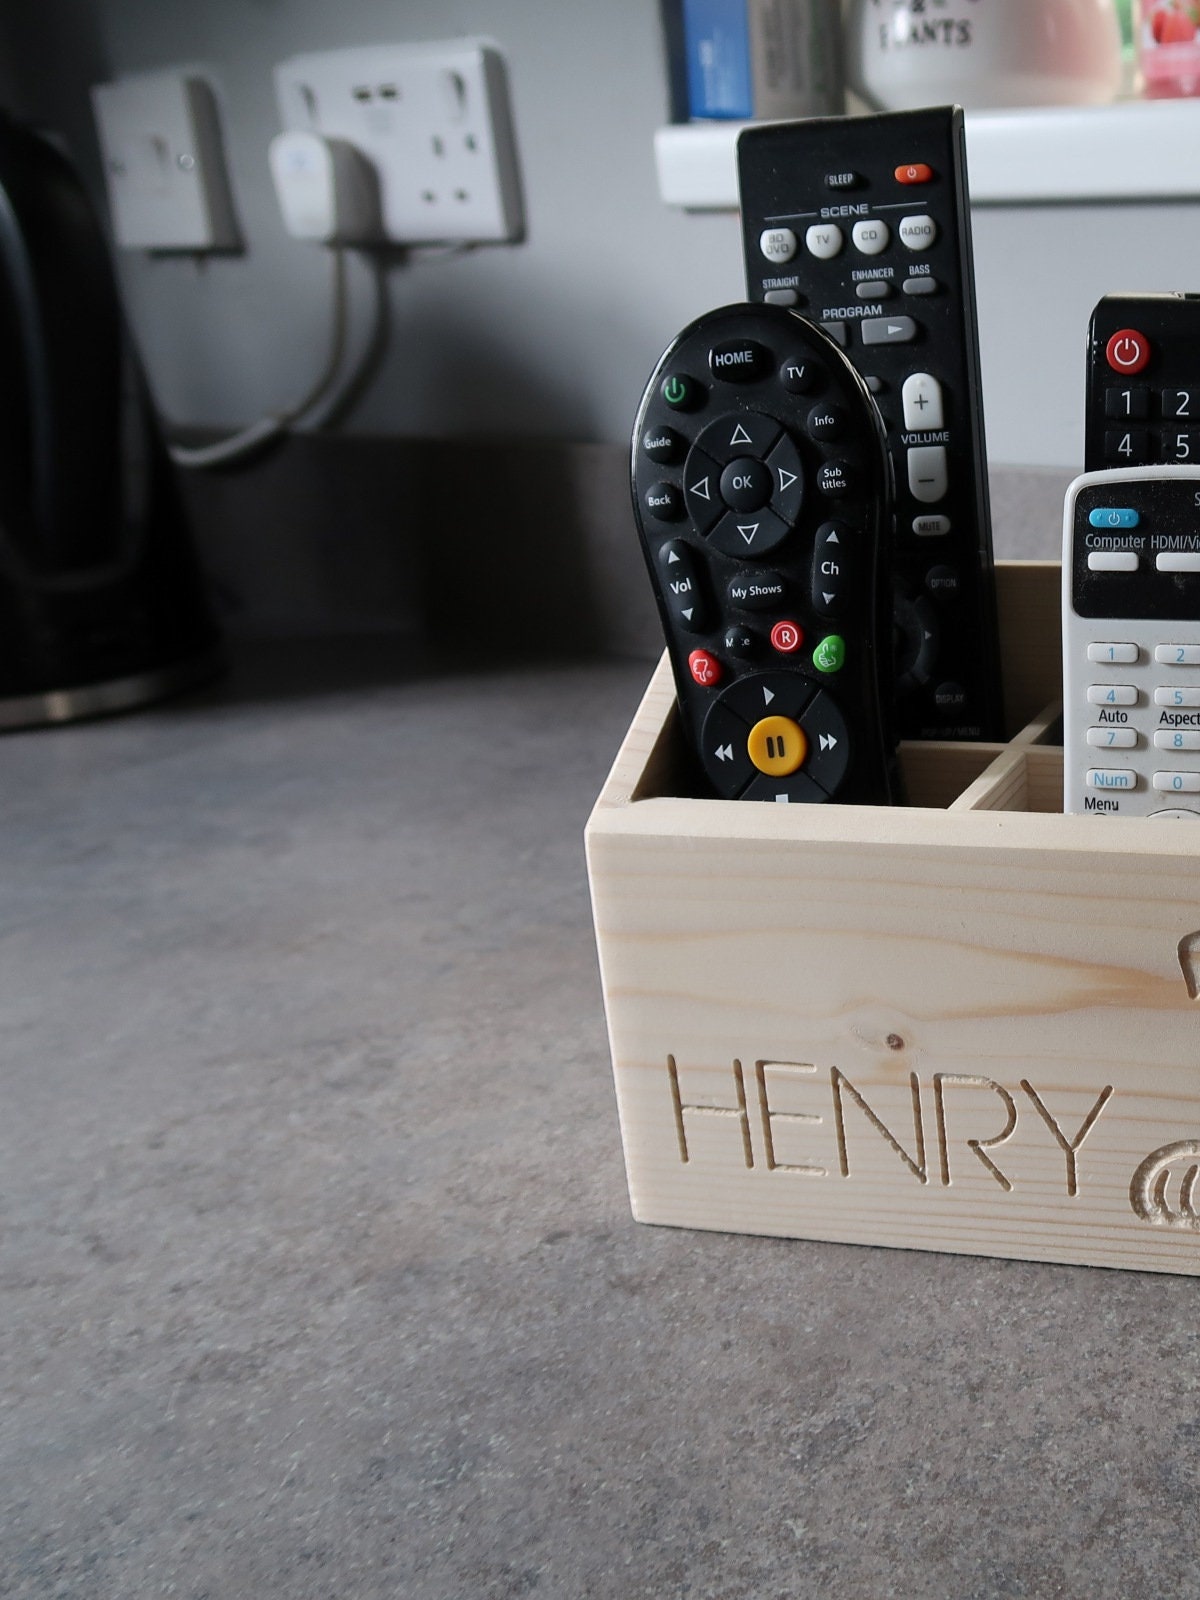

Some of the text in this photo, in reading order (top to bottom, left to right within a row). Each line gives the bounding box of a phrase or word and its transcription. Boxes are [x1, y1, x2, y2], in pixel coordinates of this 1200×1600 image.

[880, 19, 971, 51] ANTS
[829, 174, 853, 184] SLEEP
[821, 204, 869, 218] SCENE
[861, 231, 876, 240] CD
[902, 225, 930, 236] RADIO
[816, 235, 830, 244] TV
[852, 268, 893, 280] ENHANCER
[909, 265, 929, 275] BASS
[763, 276, 798, 289] STRAIGHT
[823, 305, 882, 319] PROGRAM
[715, 351, 753, 367] HOME
[787, 366, 804, 379] TV
[1122, 391, 1130, 414] 1
[1176, 392, 1189, 415] 2
[814, 415, 835, 426] Info
[645, 436, 671, 449] Guide
[901, 431, 949, 444] VOLUME
[1118, 434, 1132, 456] 4
[1176, 435, 1189, 458] 5
[823, 468, 842, 478] Sub
[733, 476, 752, 490] OK
[822, 478, 846, 488] titles
[648, 495, 671, 506] Back
[918, 521, 941, 532] MUTE
[1086, 534, 1145, 549] Computer
[821, 562, 839, 575] Ch
[670, 578, 691, 594] Vol
[732, 584, 782, 599] My Shows
[726, 638, 750, 648] Me
[782, 631, 791, 643] R
[1108, 648, 1114, 660] 1
[1177, 649, 1185, 662] 2
[936, 694, 964, 704] DISPLAY
[1106, 689, 1115, 702] 4
[1174, 692, 1182, 704] 5
[1099, 710, 1128, 723] Auto
[1160, 711, 1200, 727] Aspect
[1108, 732, 1116, 744] 7
[1174, 734, 1183, 746] 8
[1094, 773, 1128, 786] Num
[1173, 776, 1182, 789] 0
[1085, 798, 1119, 810] Menu
[667, 1054, 1114, 1197] HENRY
